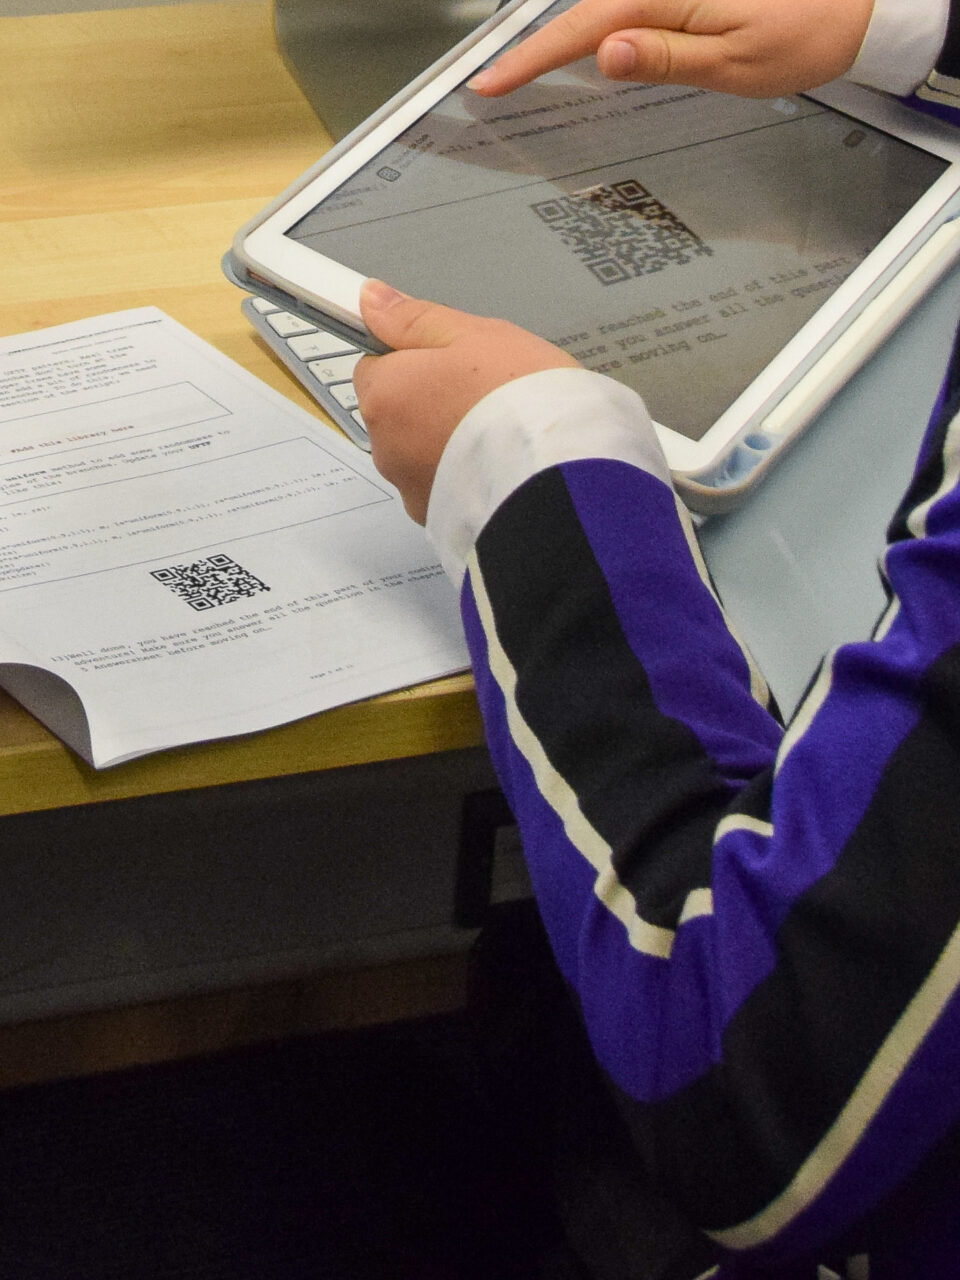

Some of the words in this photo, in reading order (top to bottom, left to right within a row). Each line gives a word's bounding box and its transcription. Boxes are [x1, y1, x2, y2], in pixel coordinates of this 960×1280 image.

[597, 307, 666, 335] reached
[672, 297, 702, 312] the
[709, 287, 739, 303] end
[743, 279, 764, 292] of
[769, 268, 808, 284] this
[814, 256, 852, 273] part
[615, 334, 648, 351] you
[655, 316, 711, 337] answer
[718, 302, 749, 319] all
[754, 292, 785, 308] the
[627, 339, 692, 364] moving
[5, 469, 47, 483] uniform
[51, 460, 87, 473] method
[108, 452, 126, 462] add
[130, 447, 153, 458] some
[158, 434, 214, 451] randomness
[38, 438, 62, 448] this
[67, 429, 107, 443] library
[111, 423, 135, 433] here
[43, 471, 62, 481] the
[122, 452, 158, 466] Update
[162, 447, 184, 459] your
[137, 638, 157, 649] you
[160, 631, 188, 642] have
[192, 618, 236, 636] reached
[239, 611, 259, 622] the
[263, 604, 284, 615] end
[287, 599, 300, 609] of
[304, 591, 330, 603] this
[334, 583, 358, 597] part
[362, 578, 375, 587] of
[380, 572, 402, 584] your
[407, 562, 444, 576] coding
[140, 643, 168, 654] Make
[172, 637, 199, 648] sure
[202, 631, 223, 642] you
[227, 618, 263, 635] answer
[268, 612, 288, 622] all
[291, 604, 312, 615] the
[315, 590, 365, 609] question
[368, 586, 381, 595] in
[384, 580, 404, 591] the
[93, 652, 163, 672] Answersheet
[167, 643, 206, 658] before
[210, 631, 250, 648] moving
